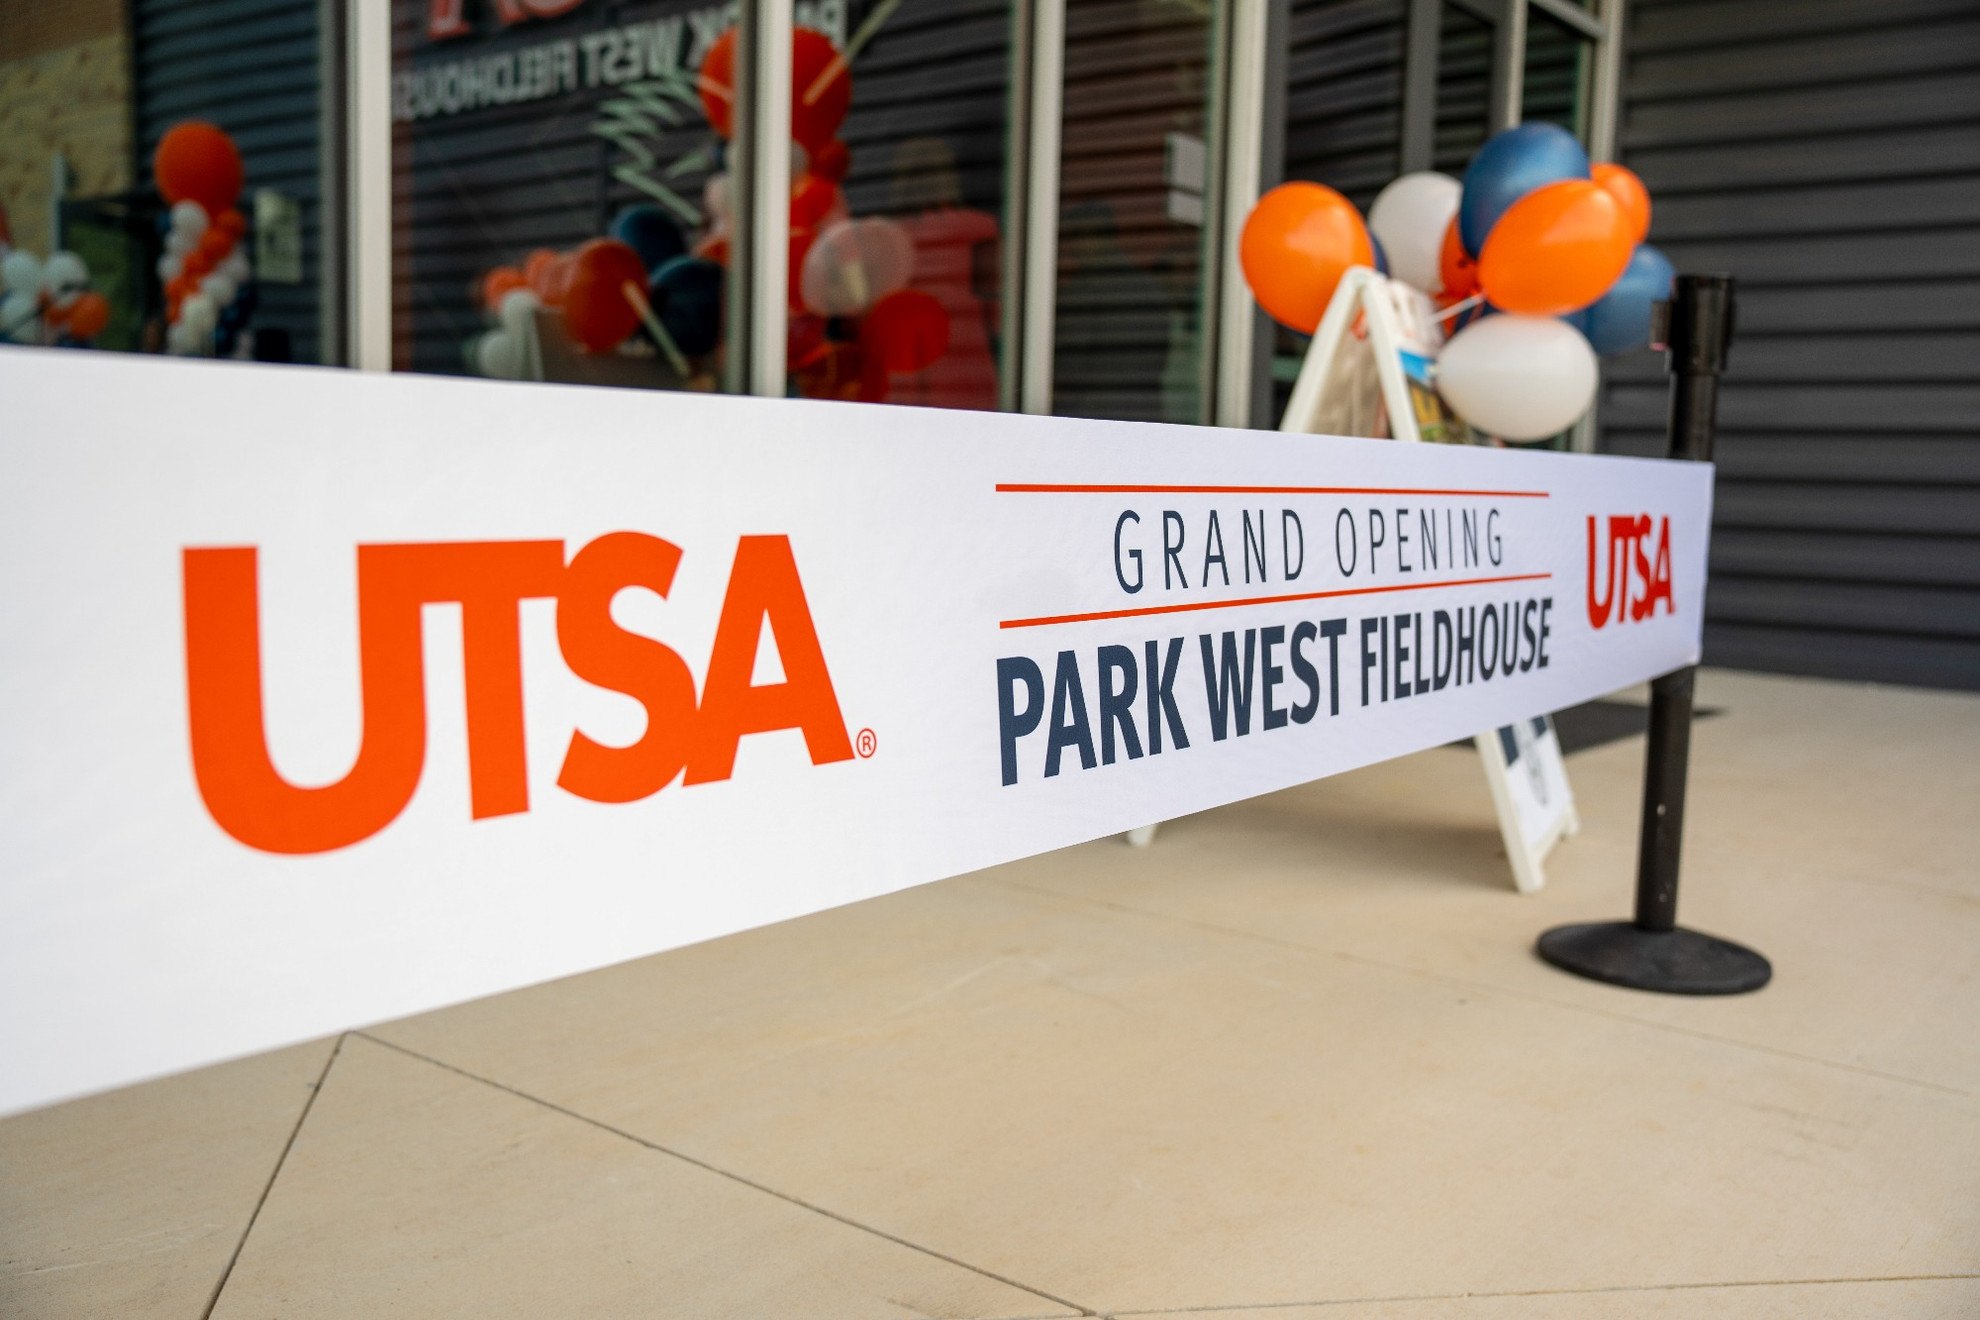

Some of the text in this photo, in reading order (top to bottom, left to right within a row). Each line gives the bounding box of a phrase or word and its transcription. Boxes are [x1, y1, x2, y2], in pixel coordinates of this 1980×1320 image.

[1113, 507, 1503, 594] GRAND OPENING
[1586, 513, 1675, 630] UTSA
[996, 596, 1553, 787] PARK WEST FIELDHOUSE
